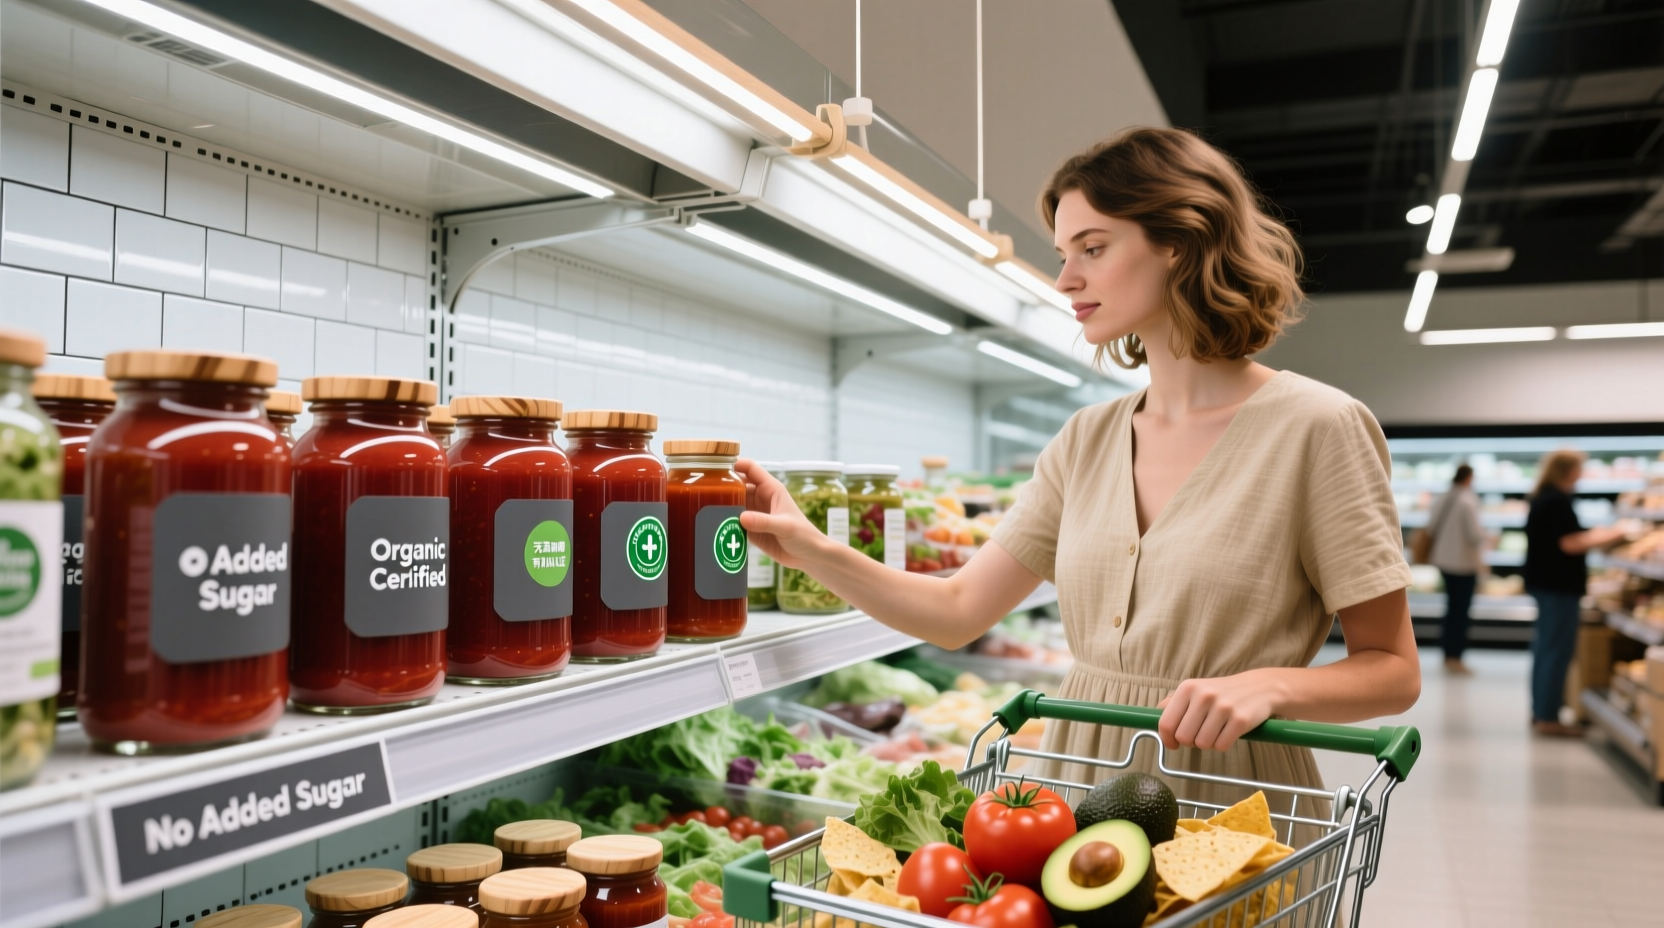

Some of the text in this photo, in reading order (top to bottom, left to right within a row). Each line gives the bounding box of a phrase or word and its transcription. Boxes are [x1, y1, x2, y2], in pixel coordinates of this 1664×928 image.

[210, 542, 287, 575] Added
[370, 537, 445, 567] Organic
[199, 579, 277, 616] Sugar
[144, 772, 366, 855] No Added Sugar
